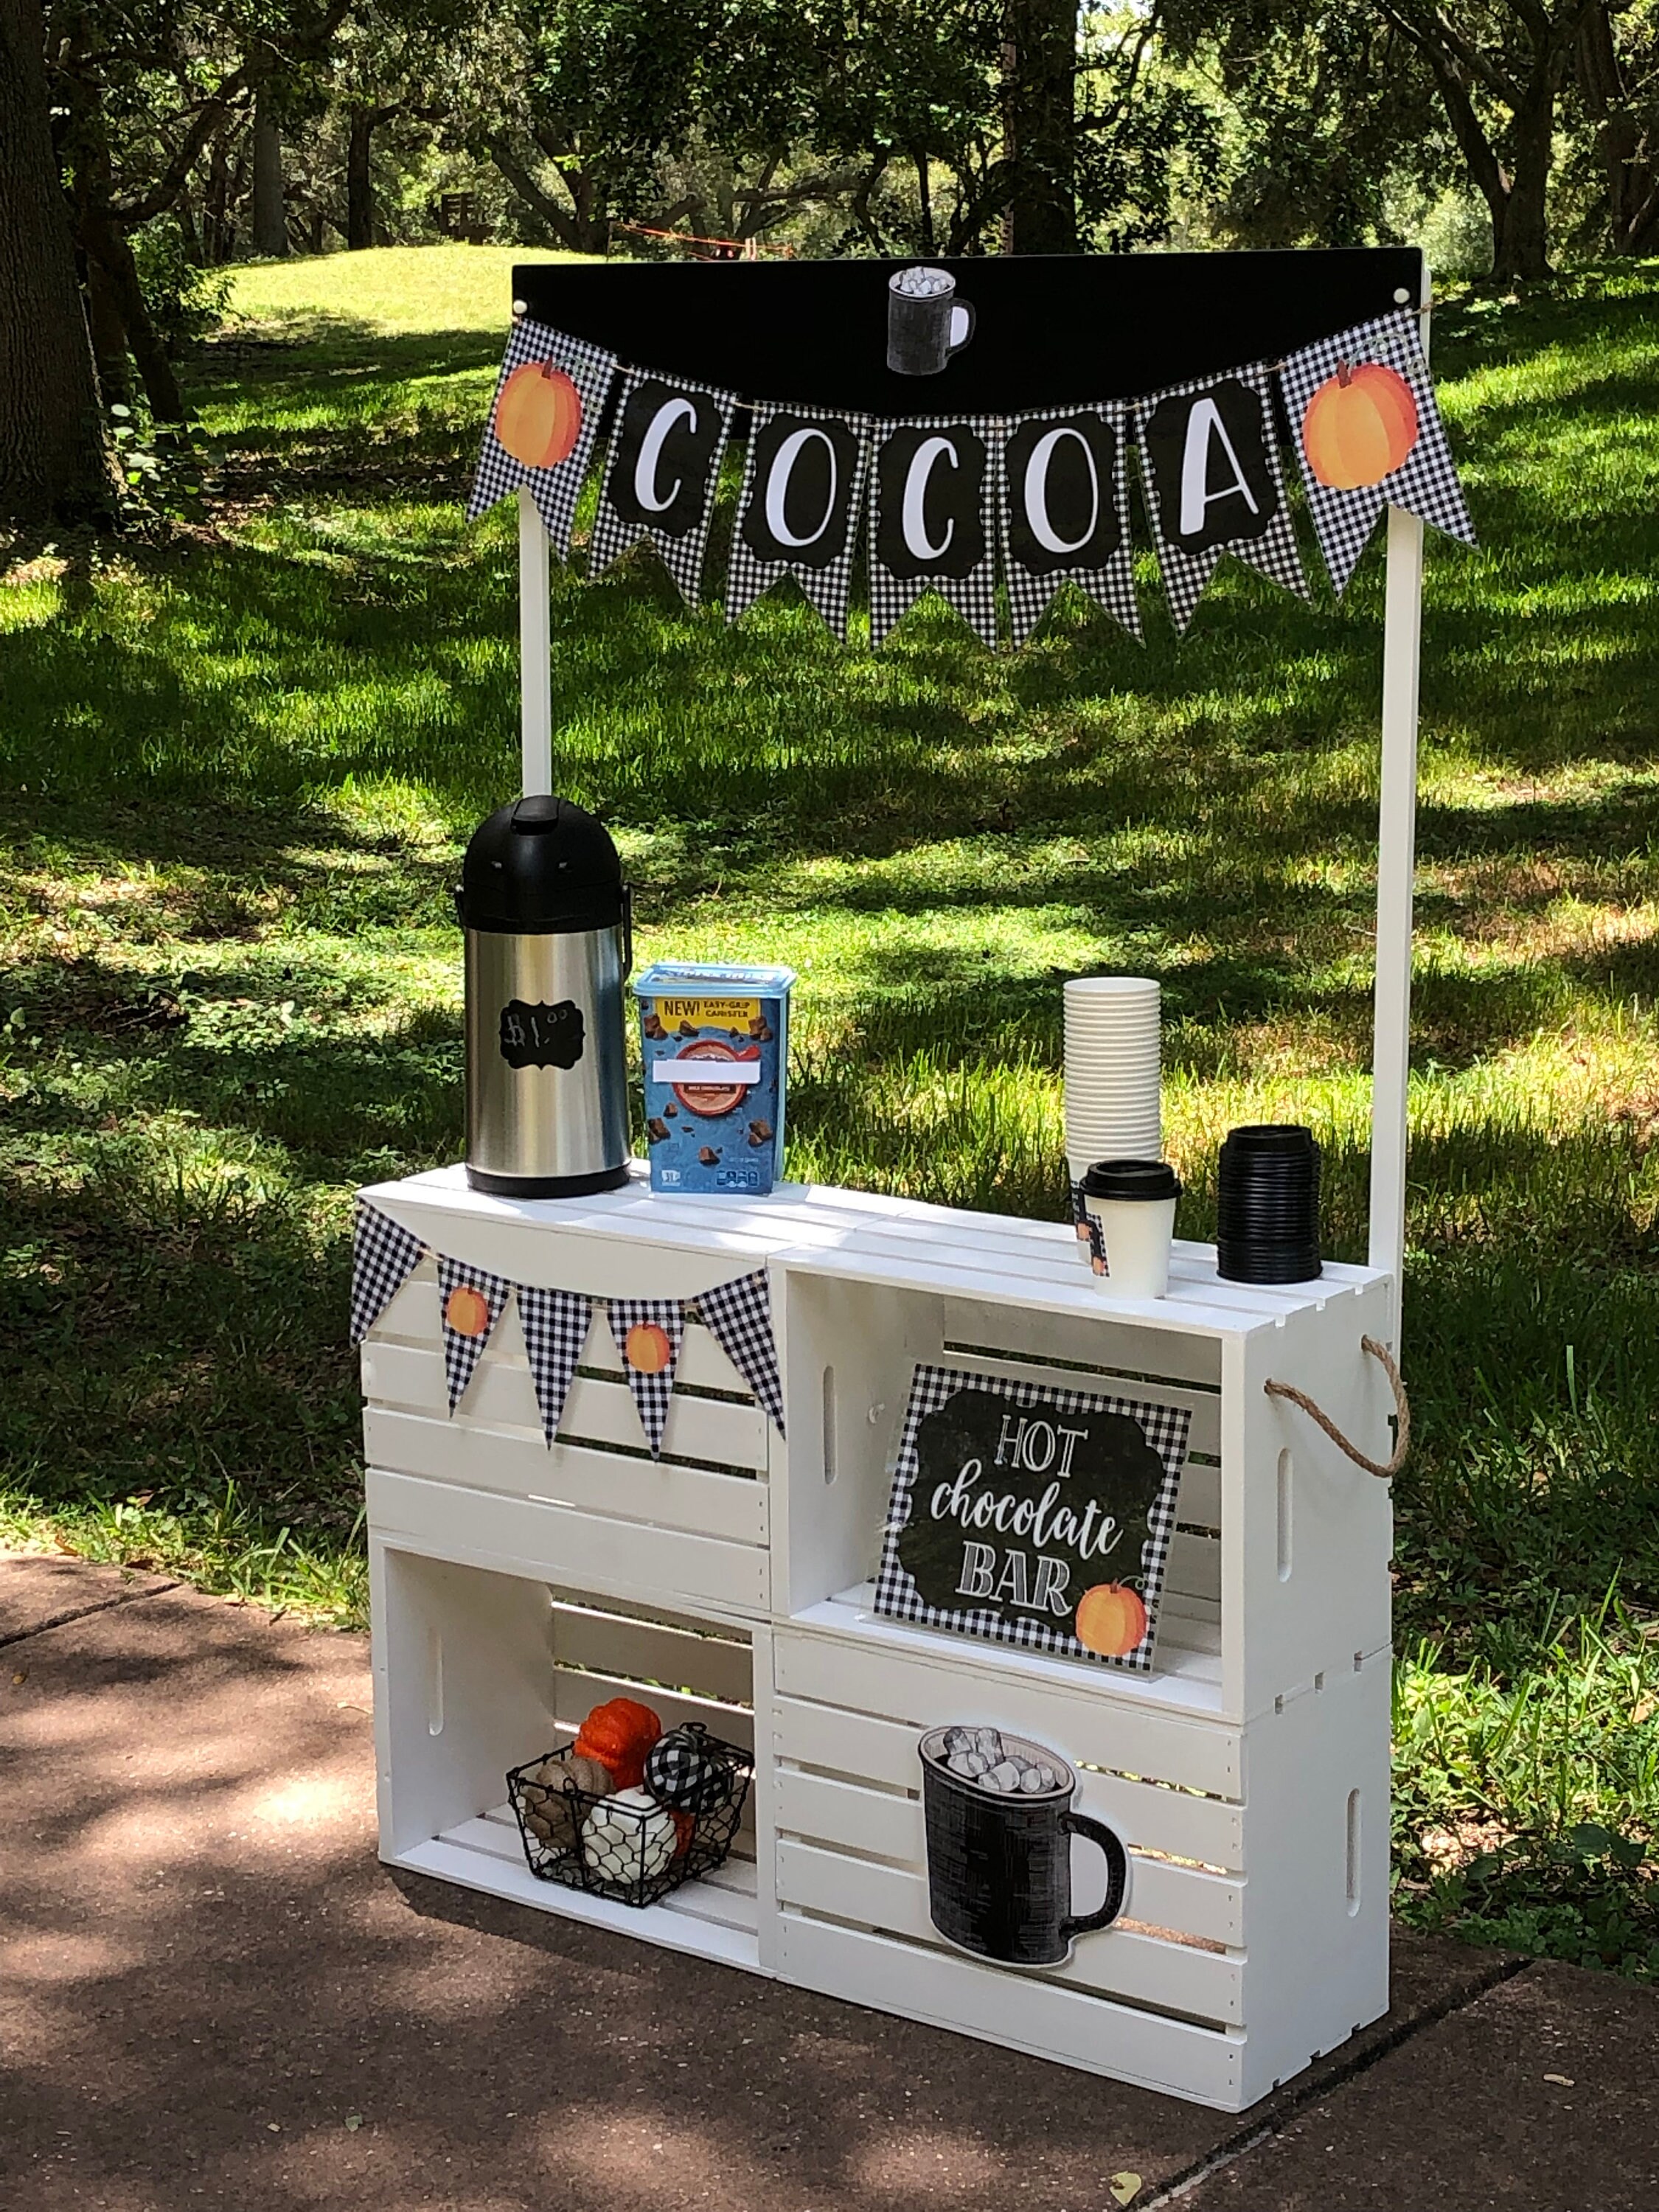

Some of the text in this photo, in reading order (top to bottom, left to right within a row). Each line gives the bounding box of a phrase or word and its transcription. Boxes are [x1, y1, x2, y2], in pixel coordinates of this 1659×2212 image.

[636, 398, 1259, 558] COCOA
[664, 1001, 700, 1016] NEW!
[993, 1413, 1088, 1478] HOT
[931, 1458, 1124, 1560] chocolate
[954, 1540, 1073, 1618] BAR
